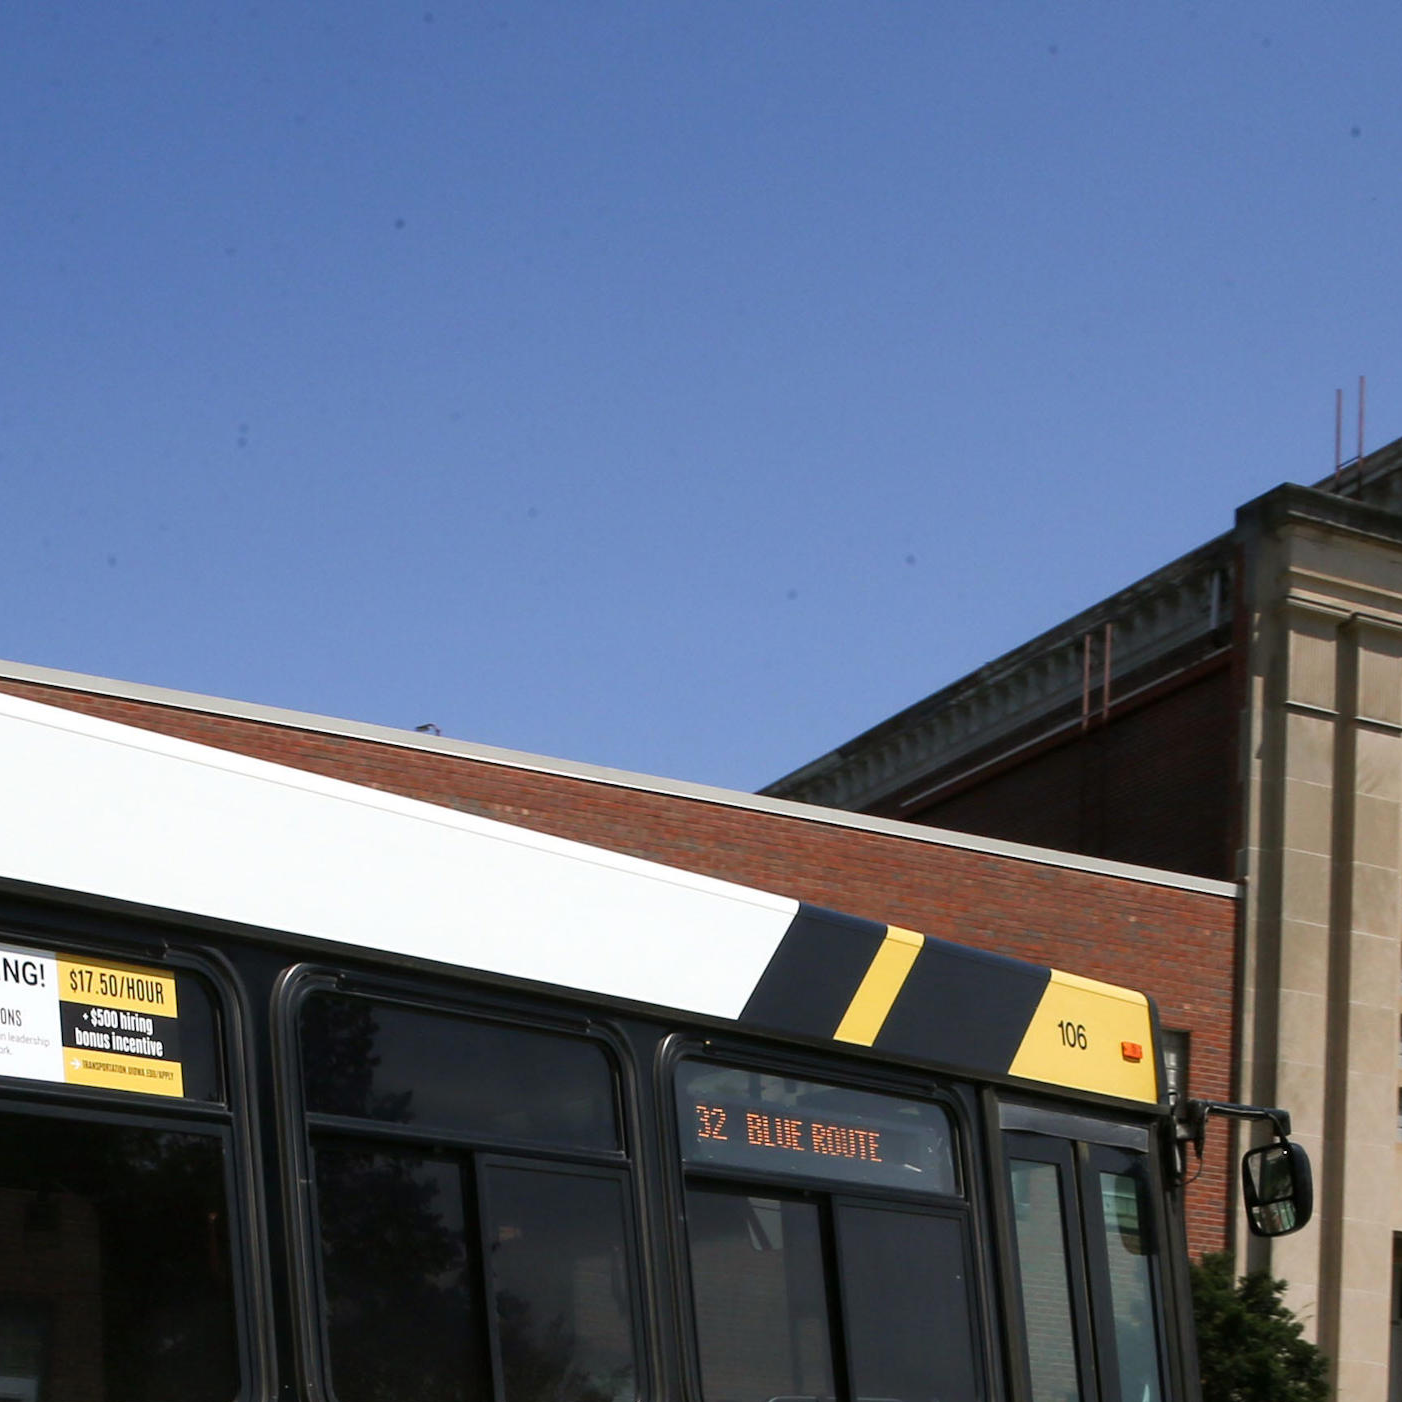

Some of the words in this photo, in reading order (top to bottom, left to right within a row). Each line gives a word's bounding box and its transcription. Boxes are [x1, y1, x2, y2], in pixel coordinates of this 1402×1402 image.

[69, 968, 164, 1005] $17.50/HOUR
[90, 1008, 119, 1029] $500
[120, 1011, 154, 1036] hiring
[1057, 1020, 1088, 1051] 106
[7, 1031, 51, 1048] leadership
[75, 1027, 111, 1050] bonus
[112, 1032, 164, 1057] incentive
[696, 1105, 728, 1141] 32
[746, 1113, 805, 1151] BLUE
[811, 1123, 883, 1162] ROUTE
